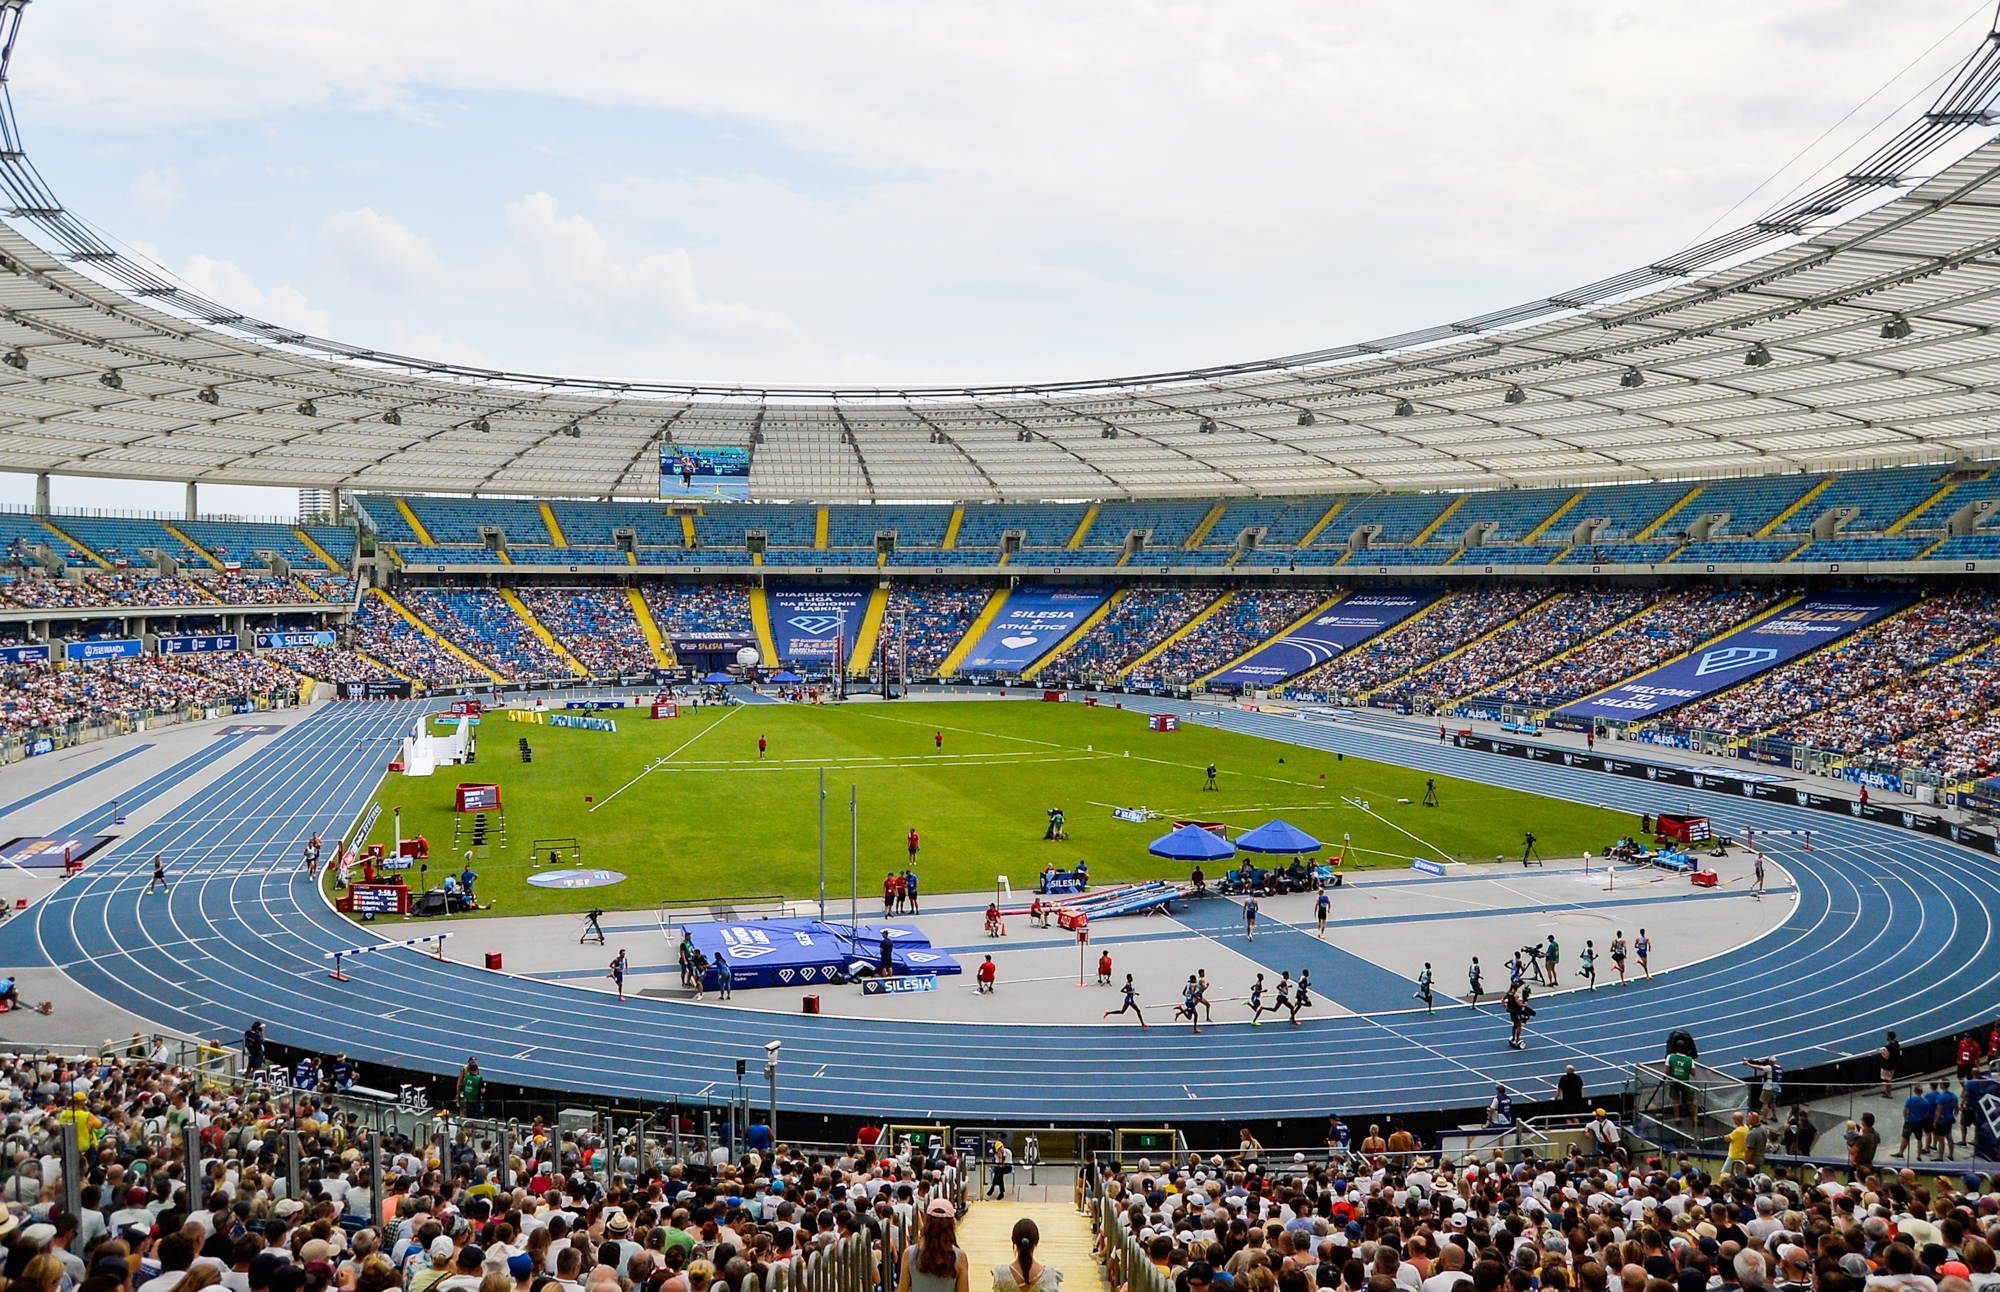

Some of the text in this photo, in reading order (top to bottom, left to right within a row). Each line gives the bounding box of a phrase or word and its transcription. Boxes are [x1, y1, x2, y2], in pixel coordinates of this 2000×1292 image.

[1010, 611, 1075, 619] SILESIA
[1780, 610, 1868, 621] SILESIA
[285, 634, 319, 645] SILESIA
[1620, 684, 1701, 698] WELCOME
[1591, 698, 1659, 710] SILESIA
[1653, 734, 1675, 747] SILESIA
[1860, 772, 1885, 786] SILESIA
[1050, 879, 1082, 888] SILESIA
[884, 978, 932, 991] SILESIA
[405, 1091, 412, 1104] 5
[420, 1094, 428, 1108] 6
[915, 1134, 921, 1143] 2
